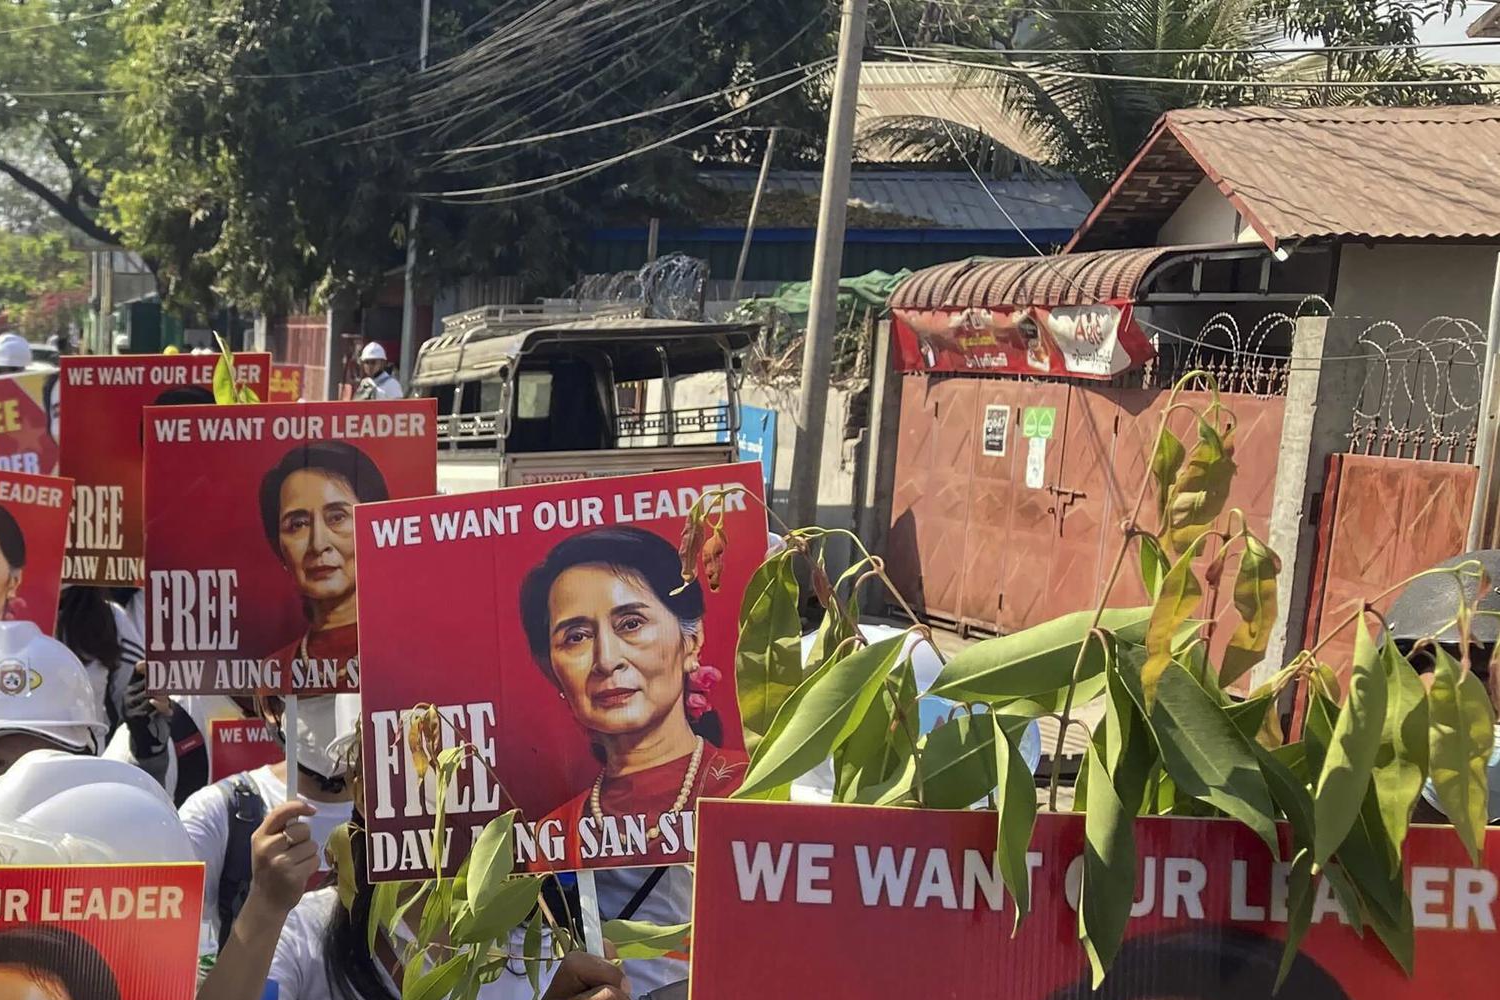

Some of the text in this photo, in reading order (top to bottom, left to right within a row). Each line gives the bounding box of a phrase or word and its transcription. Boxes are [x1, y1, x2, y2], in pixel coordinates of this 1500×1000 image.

[68, 364, 261, 385] WE WANT OUR LEER
[154, 412, 425, 443] WE WANT OUR LEADER
[536, 472, 586, 484] TOYOTA
[371, 482, 748, 549] WE WANT OUR LEADER
[61, 556, 99, 580] DAW
[150, 569, 239, 651] FREE
[148, 658, 360, 690] DAW AUNG SAN S
[219, 727, 243, 743] WE
[371, 702, 500, 819] FREE
[371, 827, 454, 873] DAW
[470, 819, 565, 864] NG
[579, 814, 647, 861] SAN
[731, 841, 835, 904] WE
[41, 886, 185, 921] LEADER
